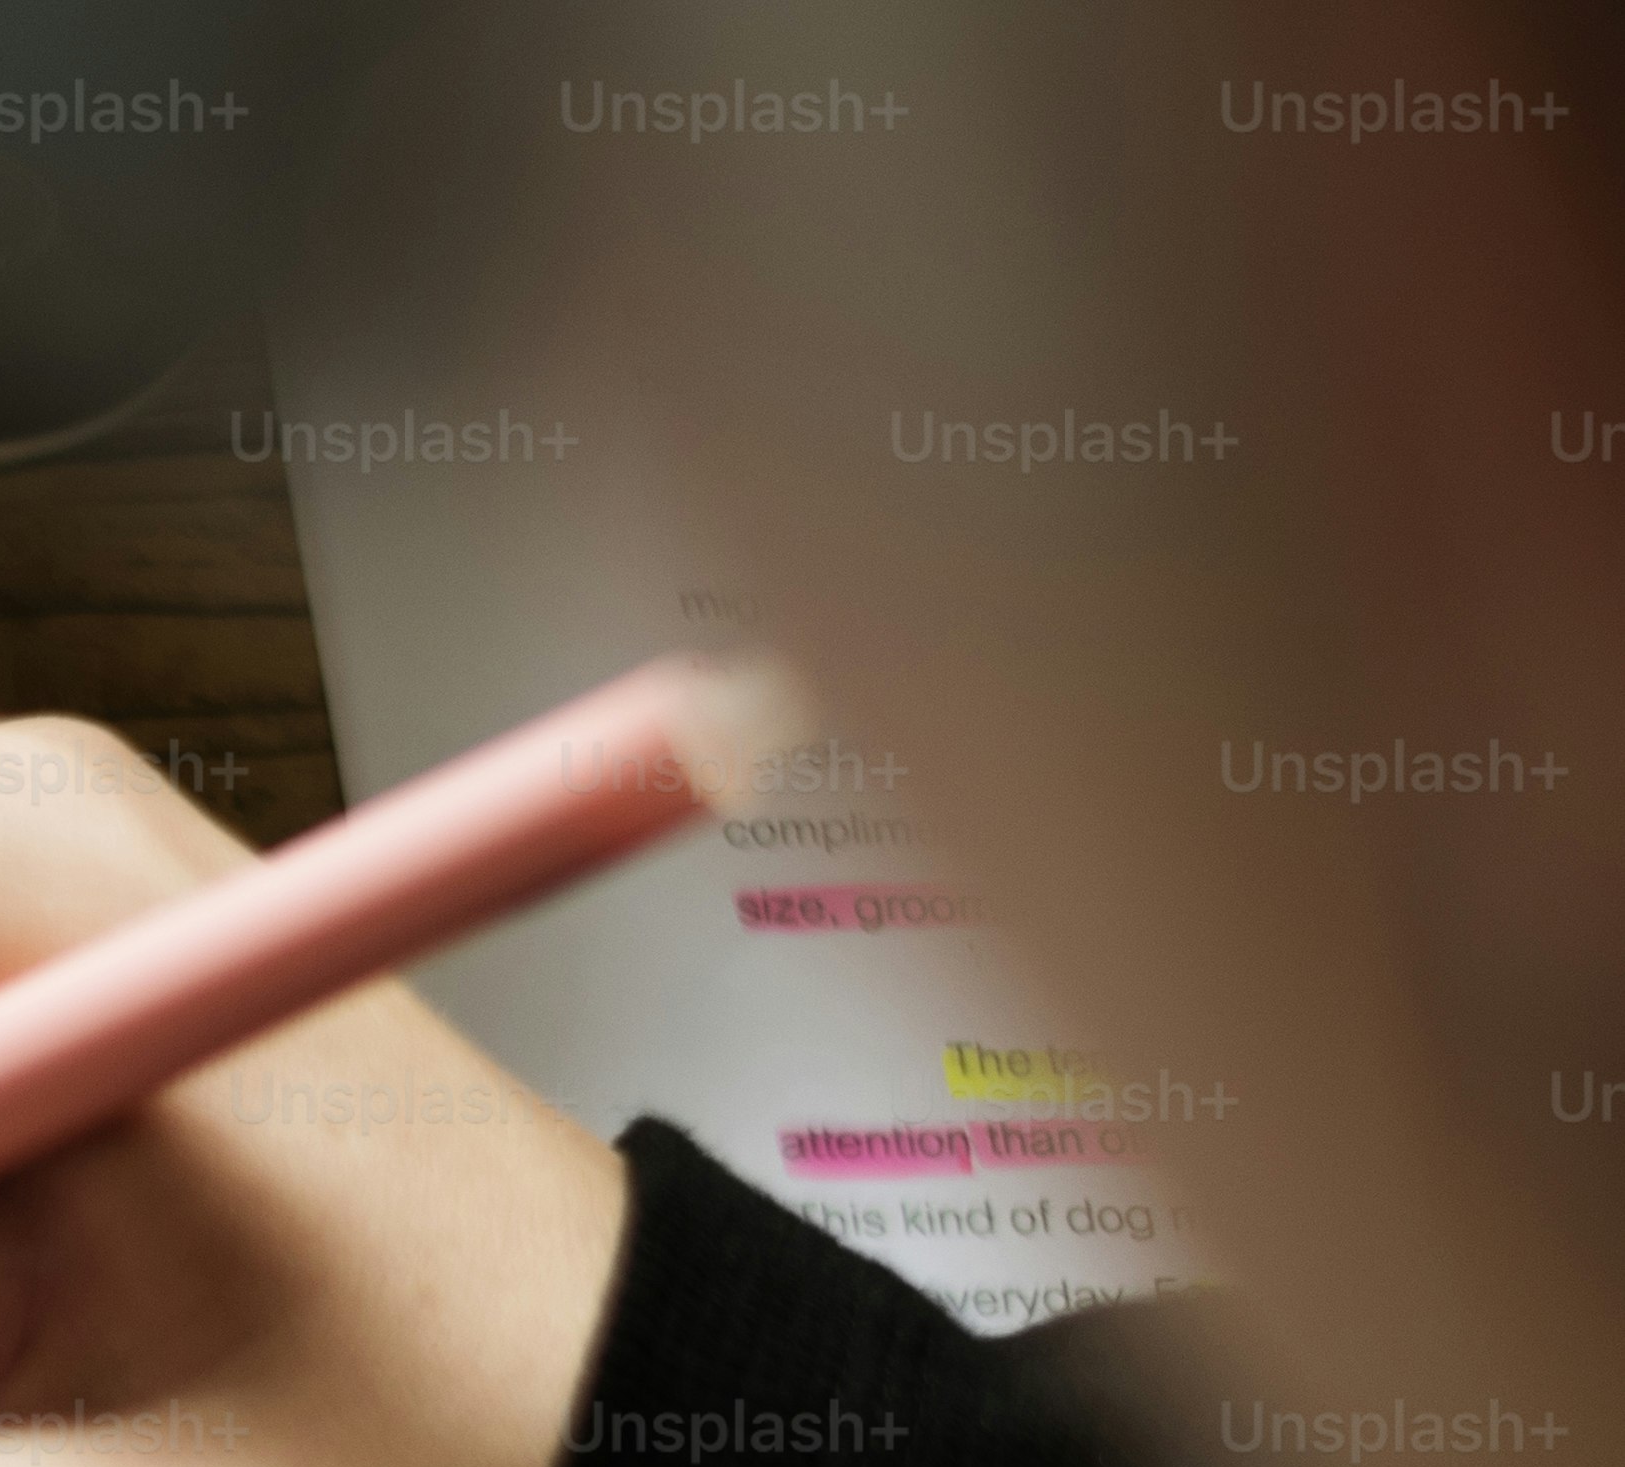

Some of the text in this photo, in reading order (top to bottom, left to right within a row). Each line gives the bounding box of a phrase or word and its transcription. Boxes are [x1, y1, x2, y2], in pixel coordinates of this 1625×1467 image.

[736, 890, 839, 929] size,
[949, 1040, 1033, 1082] The
[782, 1122, 1085, 1164] attention than
[901, 1200, 996, 1240] kind
[1066, 1201, 1155, 1245] dog
